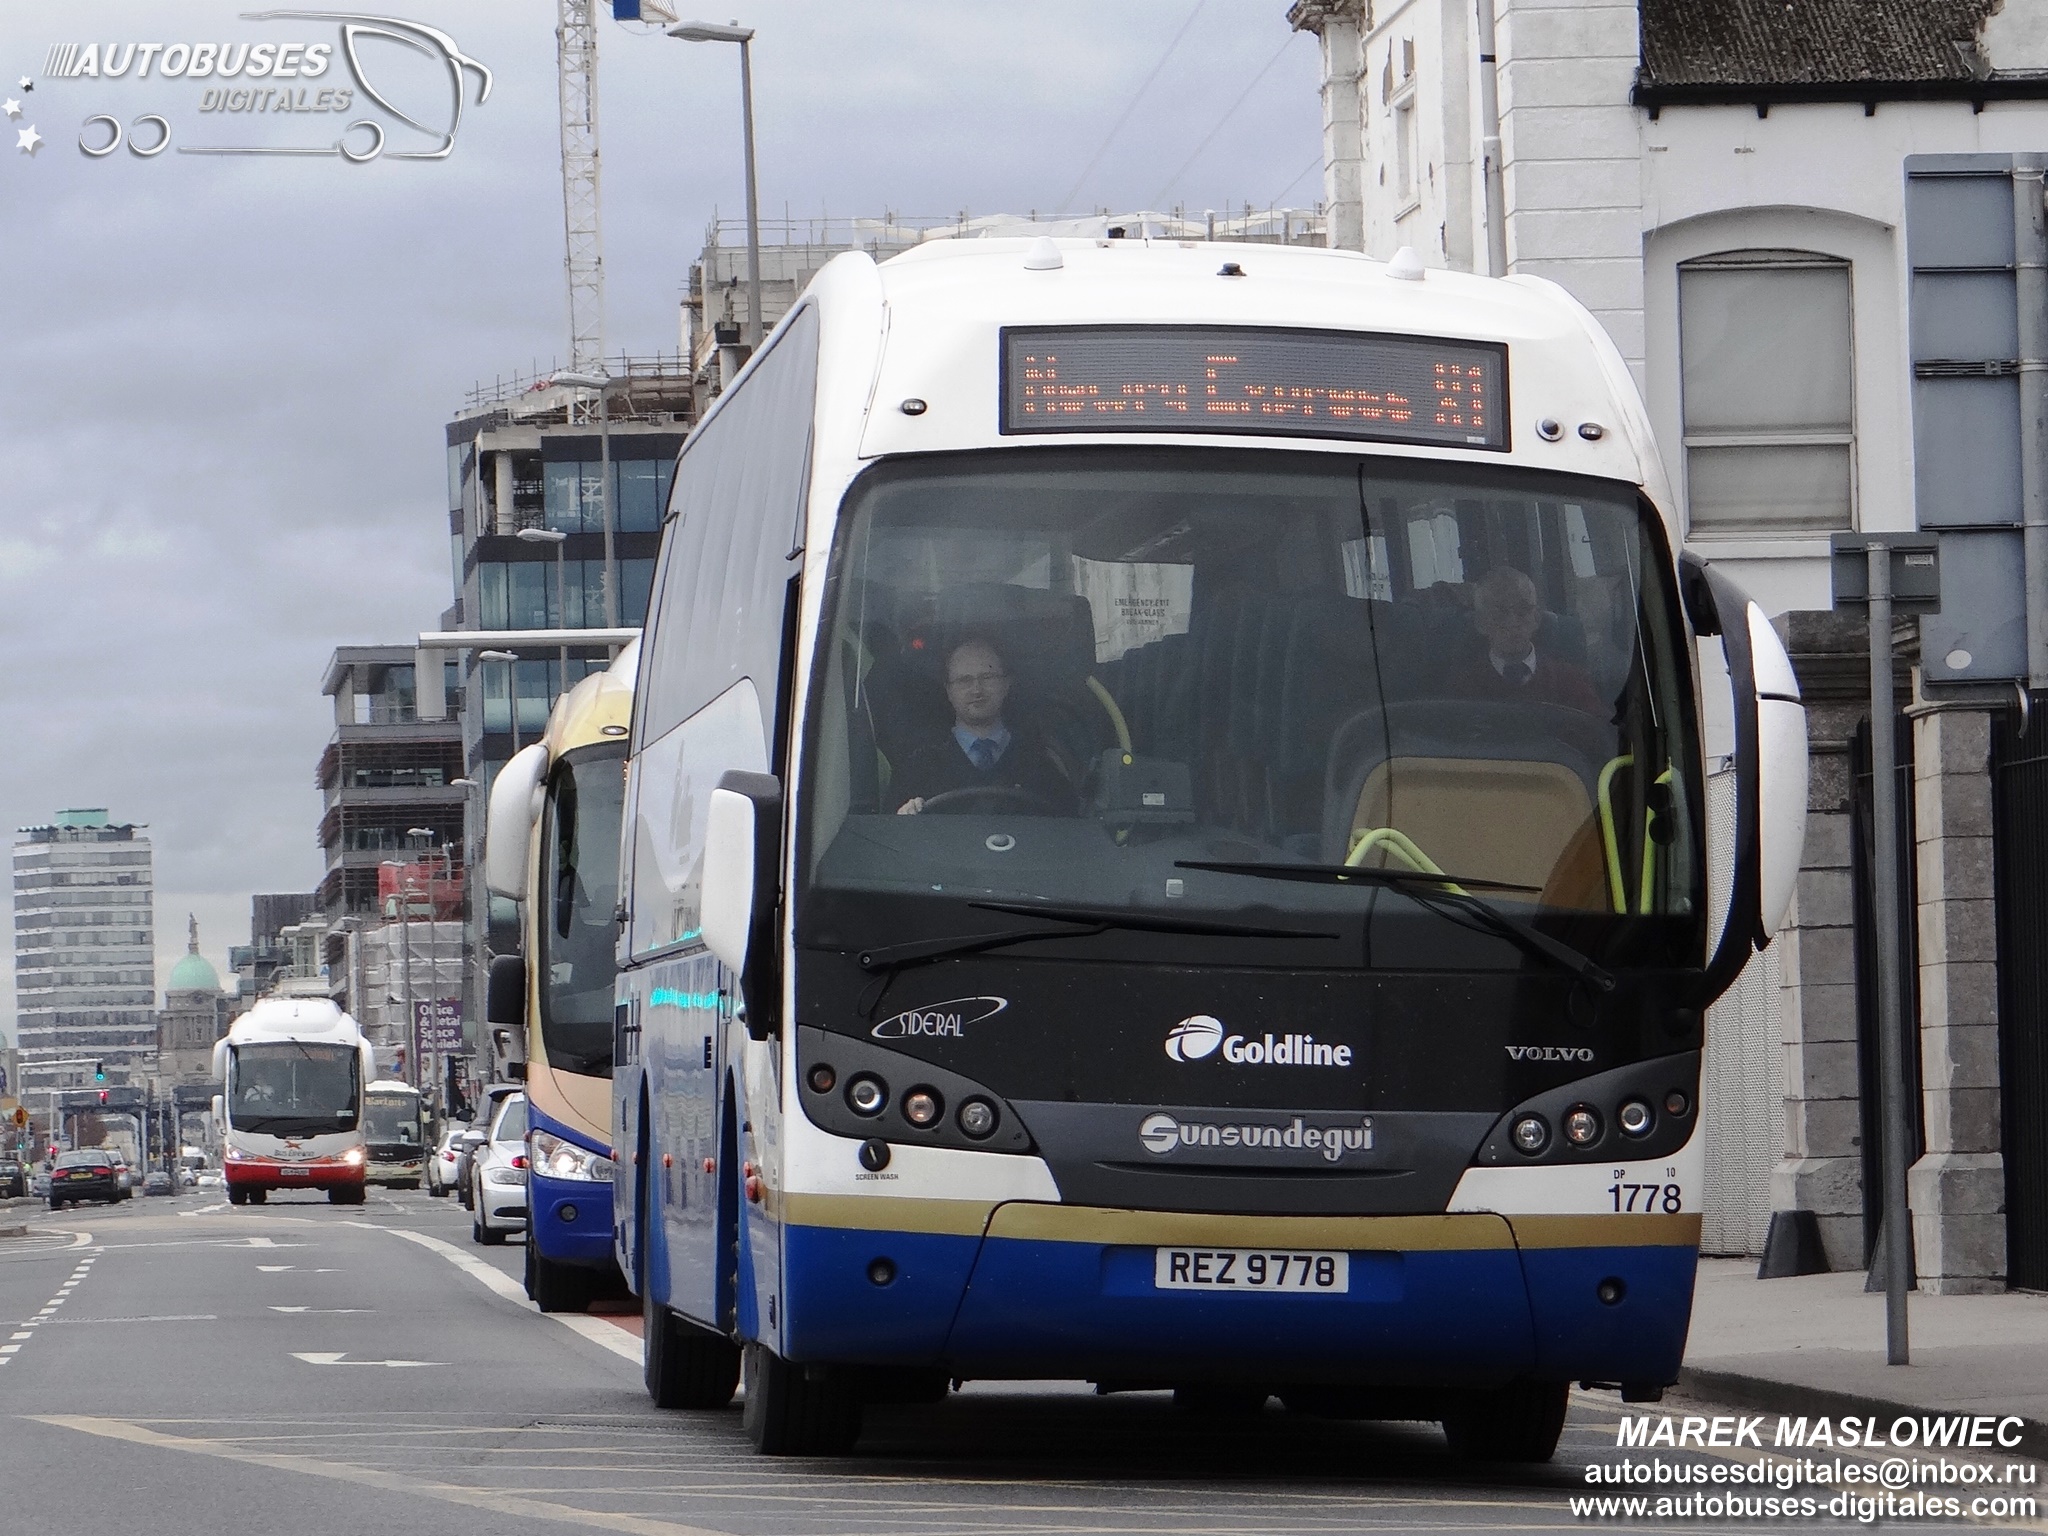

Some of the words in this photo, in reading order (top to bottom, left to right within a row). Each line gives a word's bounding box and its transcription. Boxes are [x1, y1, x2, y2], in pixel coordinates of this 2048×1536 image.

[900, 1012, 964, 1037] SIDERAL
[1223, 1034, 1352, 1066] Goldline
[1505, 1046, 1594, 1061] VOLVO
[1140, 1114, 1374, 1162] Sunsundegui
[1613, 1169, 1626, 1179] DP
[1665, 1167, 1676, 1178] 10
[1608, 1184, 1682, 1214] 1778
[1170, 1252, 1236, 1284] REZ
[1247, 1255, 1335, 1287] 9778
